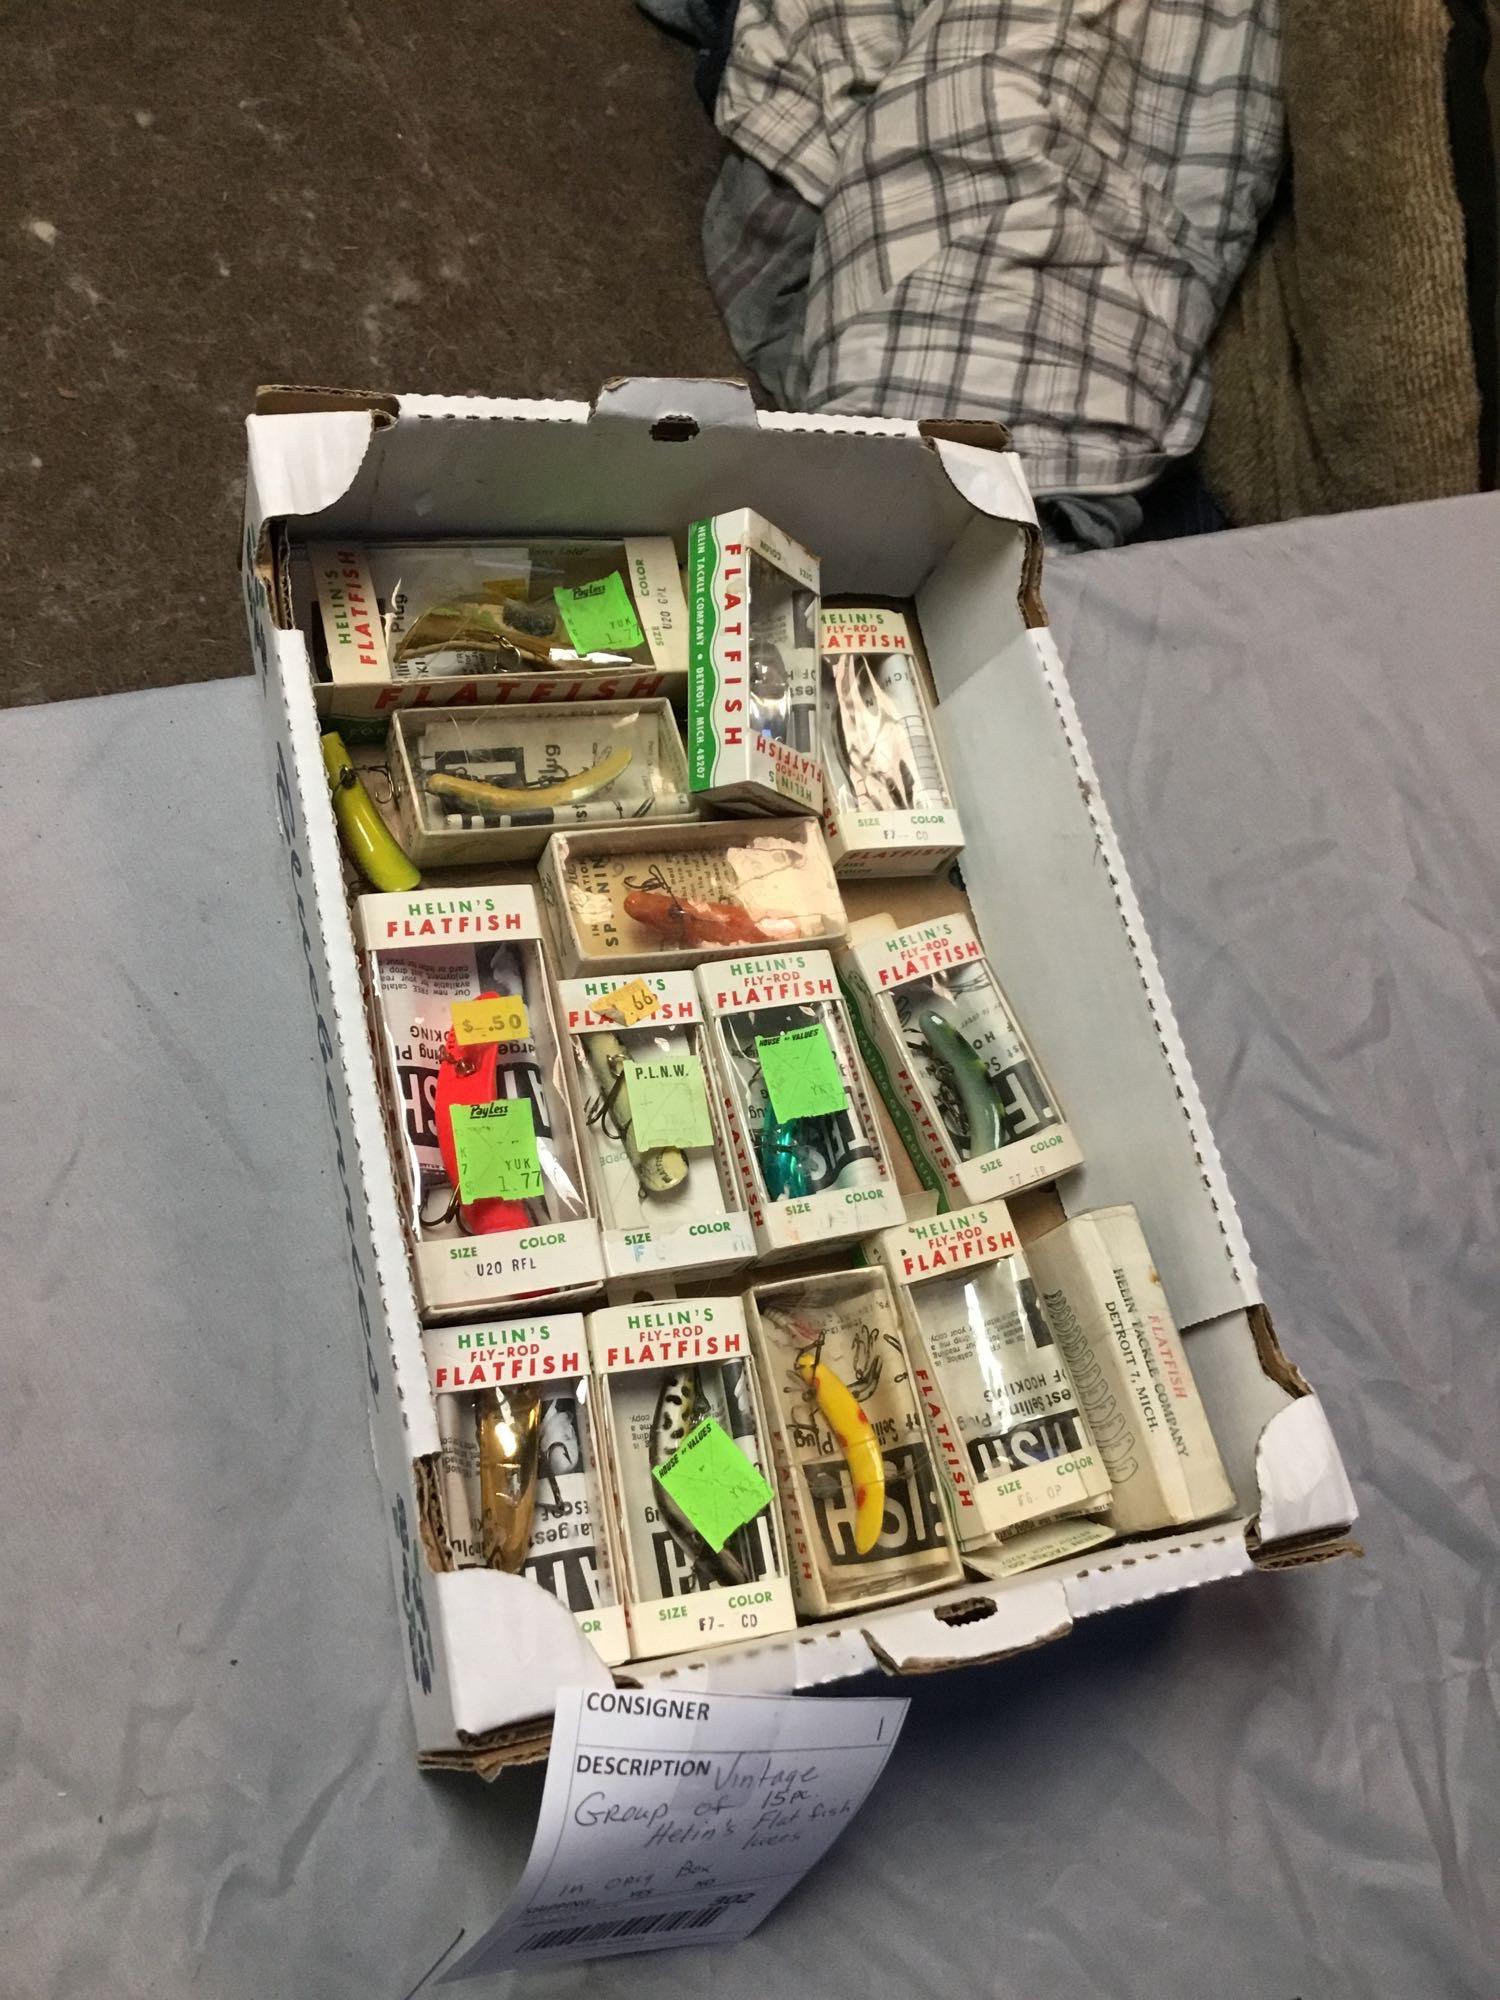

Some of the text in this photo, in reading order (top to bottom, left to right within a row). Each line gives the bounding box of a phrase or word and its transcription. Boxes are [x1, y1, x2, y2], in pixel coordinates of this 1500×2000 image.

[697, 525, 706, 554] HELIN
[633, 557, 650, 597] COLOR
[696, 557, 706, 594] TACKLE
[325, 570, 352, 645] HELIN'S
[337, 551, 378, 666] FLATFISH
[695, 597, 705, 646] COMPANY
[820, 634, 906, 649] ATFISH
[826, 624, 878, 634] FLY-ROD
[724, 543, 742, 745] FLATFISH
[374, 675, 664, 710] FLATFISH
[695, 748, 705, 779] 48207
[756, 735, 822, 783] FLATFISH
[911, 816, 945, 825] COLOR
[408, 899, 496, 917] HELIN'S
[387, 913, 522, 938] FLATFISH
[886, 923, 952, 953] HELIN'S
[879, 940, 980, 986] FLATFISH
[900, 937, 950, 961] FLY-ROD
[730, 957, 806, 977] HELIN'S
[744, 970, 800, 988] FLY-ROD
[381, 983, 407, 994] catalo
[454, 989, 471, 997] Our
[585, 978, 666, 996] HE'S
[717, 979, 833, 1009] FLATFISH
[568, 1002, 694, 1027] FLASH
[409, 1025, 450, 1042] OKING
[791, 1028, 819, 1041] VALUES
[497, 1040, 536, 1056] arge
[635, 1064, 689, 1081] P.L.N.W.
[470, 1102, 508, 1119] PayLess
[898, 1069, 961, 1188] FLATFISH
[505, 1158, 531, 1171] YUK
[980, 1135, 1064, 1174] SIZE COLOR
[785, 1188, 884, 1216] SIZE COLOR
[624, 1221, 731, 1246] SIZE COLOR
[915, 1210, 989, 1241] HELIN'S
[928, 1226, 983, 1249] FLY-ROD
[449, 1233, 566, 1260] SIZE COLOR
[904, 1230, 1016, 1276] FLATFISH
[476, 1258, 537, 1277] U20 RFL
[627, 1307, 714, 1330] HELIN'S
[457, 1325, 551, 1349] HELIN'S
[639, 1325, 704, 1343] FLY-ROD
[470, 1343, 540, 1363] FLY-ROD
[607, 1334, 741, 1367] FLATFISH
[1113, 1267, 1190, 1458] HELIN TACKLE COMPANY
[1148, 1314, 1188, 1400] FLATFISH
[436, 1352, 579, 1388] FLATFISH
[1105, 1300, 1137, 1365] DETROIT
[1135, 1387, 1160, 1433] MICH.
[658, 1423, 712, 1479] HOUSE VALUES
[916, 1368, 973, 1508] FLATFISH
[996, 1455, 1094, 1497] SIZE COLOR
[659, 1591, 773, 1621] SIZE COLOR
[586, 1691, 711, 1722] CONSIGNER
[576, 1754, 712, 1777] DESCRIPTION
[715, 1751, 818, 1792] Vintage
